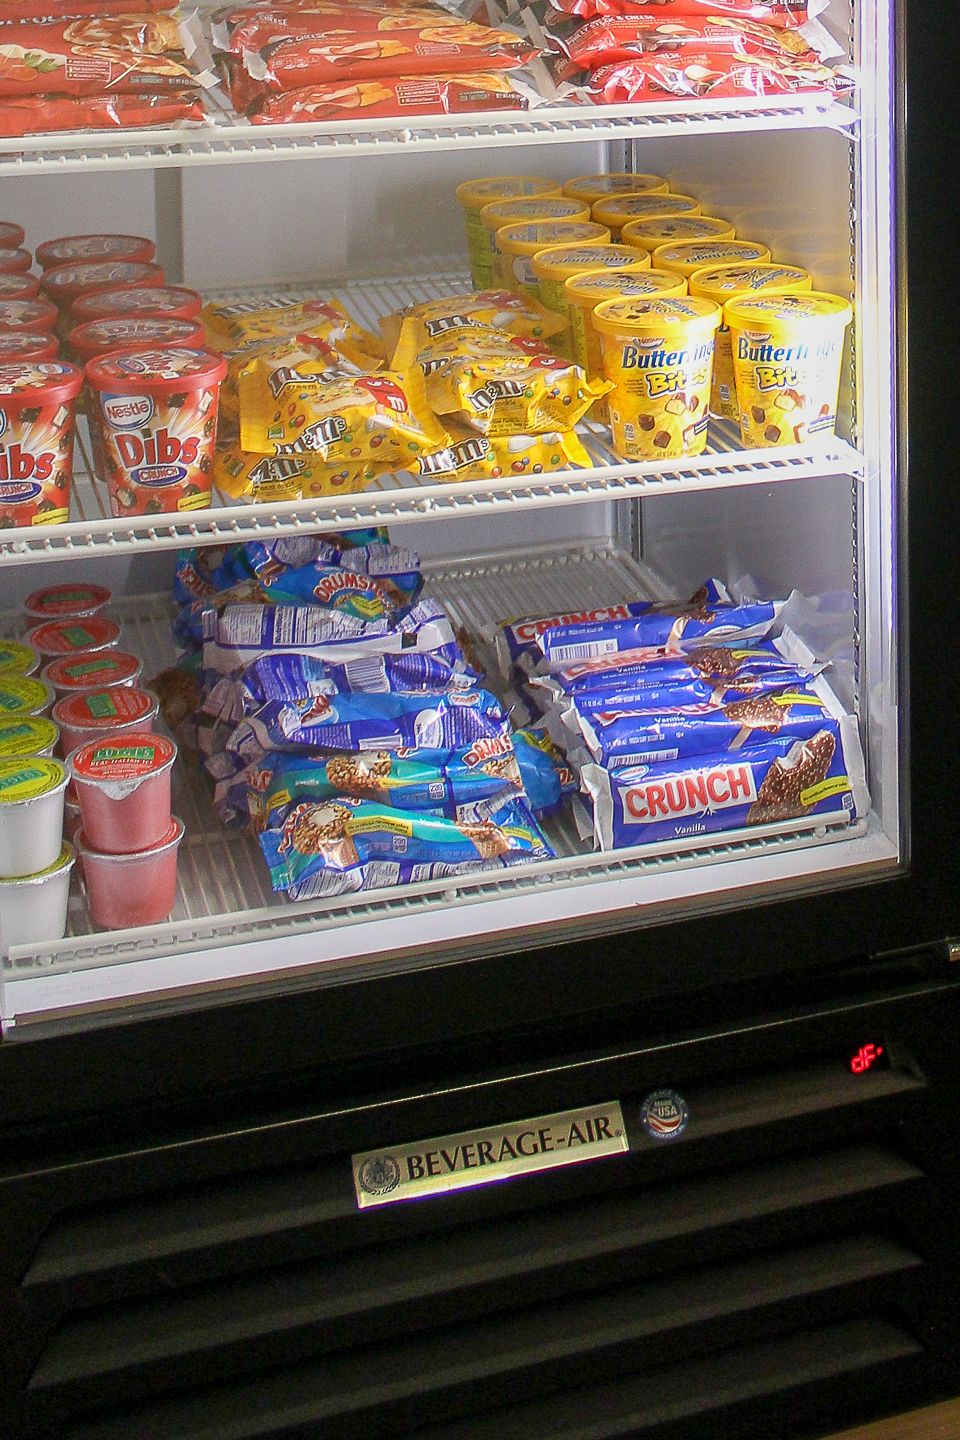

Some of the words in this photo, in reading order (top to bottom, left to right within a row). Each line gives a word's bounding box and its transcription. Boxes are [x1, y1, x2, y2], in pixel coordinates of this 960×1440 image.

[114, 428, 201, 469] Dibs
[0, 444, 56, 481] ibs
[140, 467, 178, 482] CRUNCH
[0, 483, 33, 497] RUNCH
[625, 767, 751, 818] CRUNCH
[674, 824, 706, 835] Vanilla
[658, 1105, 678, 1117] USA
[406, 1116, 617, 1181] BEVERAGE-AIR
